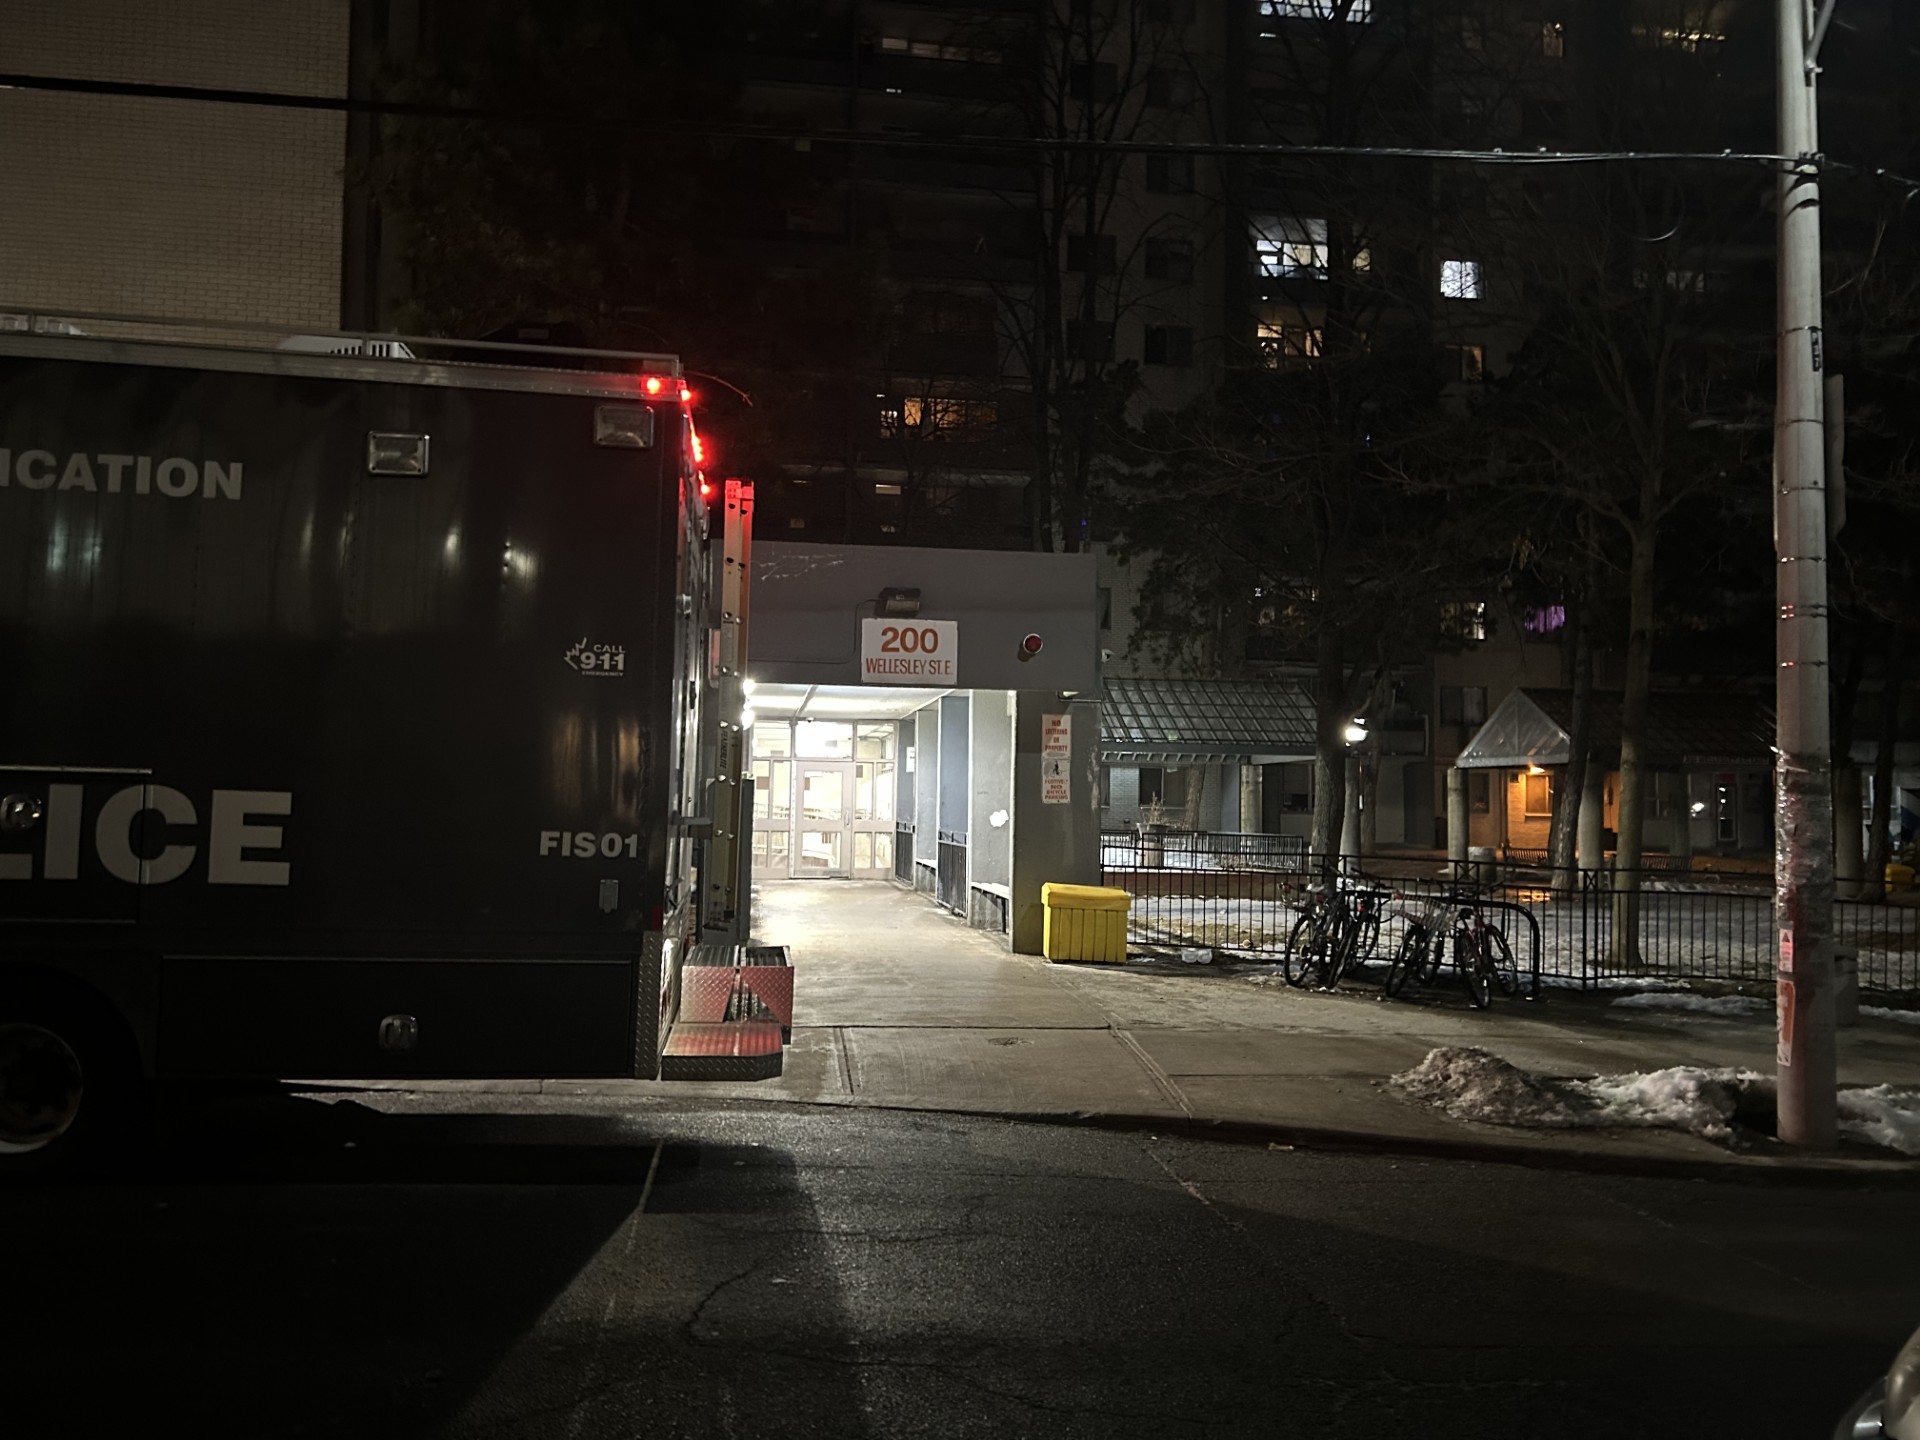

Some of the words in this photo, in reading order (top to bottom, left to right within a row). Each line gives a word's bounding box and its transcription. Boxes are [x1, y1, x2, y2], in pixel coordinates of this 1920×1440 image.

[593, 644, 626, 653] CALL
[881, 626, 938, 654] 200
[580, 652, 624, 670] 9-1-1
[866, 658, 926, 675] WELLESLEY
[540, 830, 638, 858] FIS01
